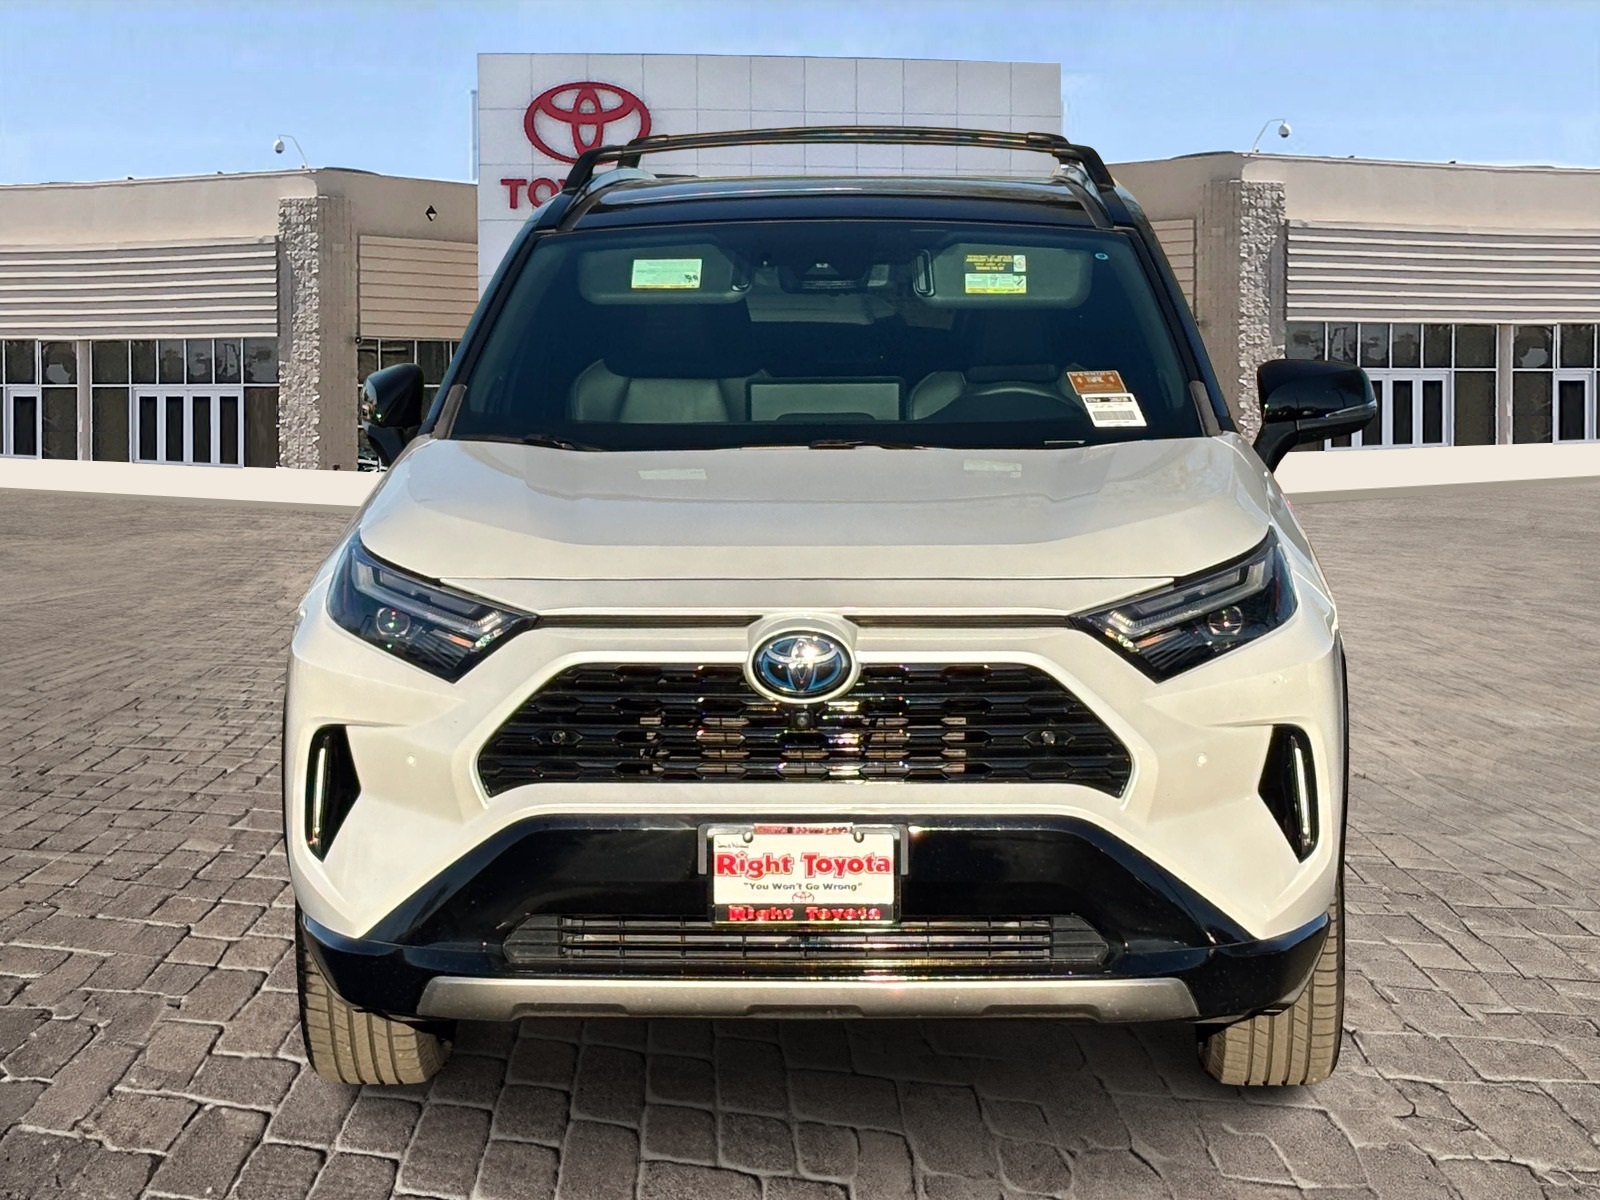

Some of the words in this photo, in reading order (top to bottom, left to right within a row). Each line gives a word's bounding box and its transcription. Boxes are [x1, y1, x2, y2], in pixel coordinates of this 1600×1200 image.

[501, 177, 567, 209] TO
[715, 852, 794, 879] Right
[803, 853, 892, 878] Toyota
[772, 882, 802, 891] Won't
[805, 882, 820, 891] Go
[728, 905, 794, 921] Right
[805, 906, 881, 921] Toyota
